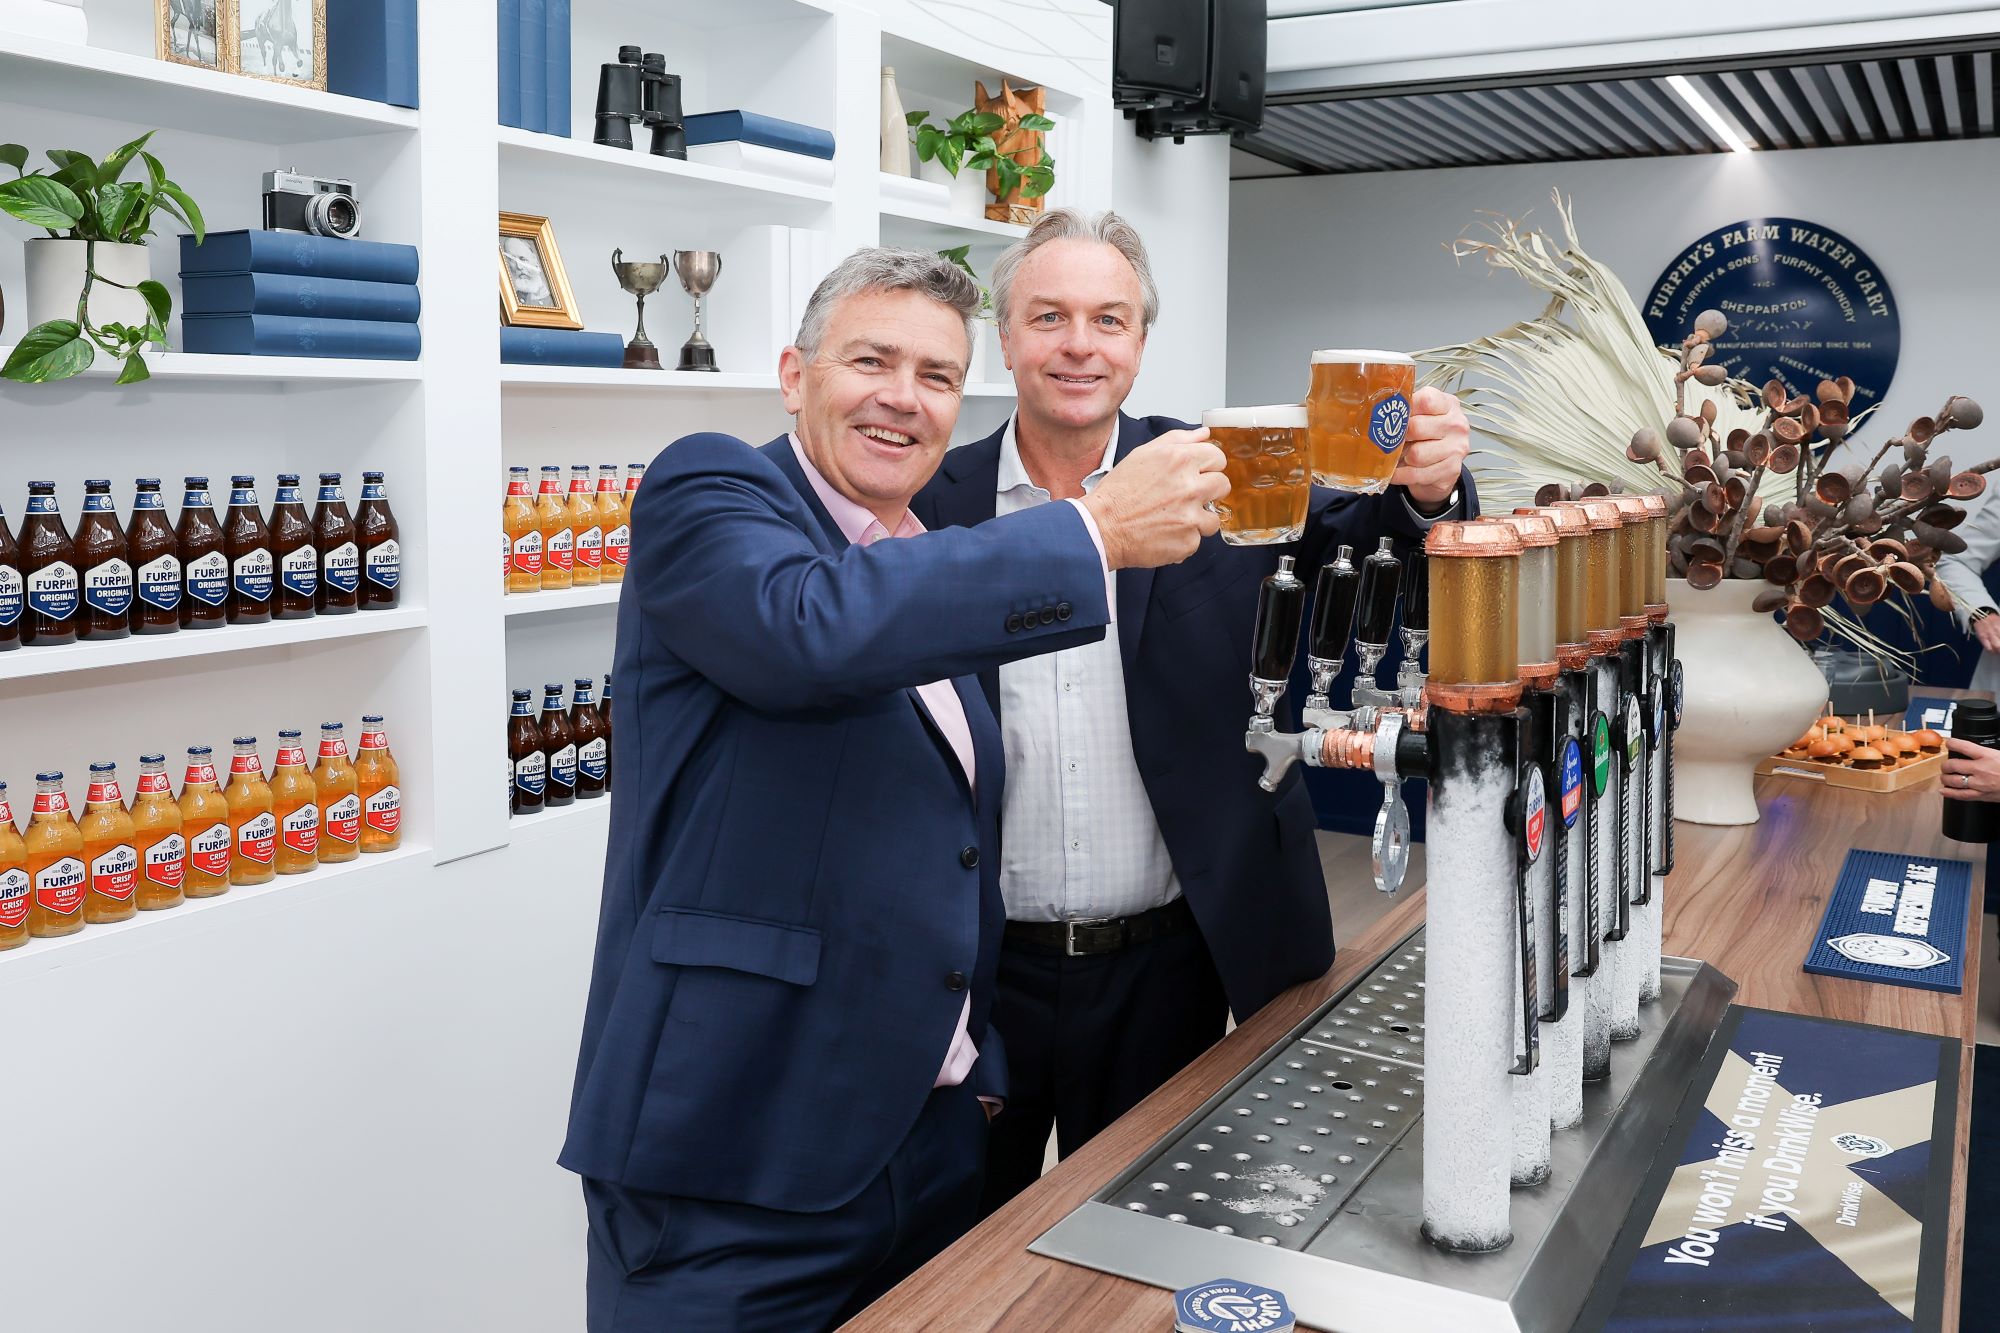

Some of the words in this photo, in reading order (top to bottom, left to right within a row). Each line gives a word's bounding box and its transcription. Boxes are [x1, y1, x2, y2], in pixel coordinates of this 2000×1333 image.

[1727, 254, 1760, 270] SONS
[1649, 242, 1715, 318] FURPHY'S
[1721, 225, 1780, 249] FARM
[1790, 227, 1856, 269] WATER
[1854, 269, 1889, 317] CART
[1773, 253, 1823, 277] FURPHY
[1821, 275, 1856, 323] FOUNDRY
[1720, 299, 1807, 314] SHEPPARTON
[1377, 399, 1408, 419] FURPHY
[36, 579, 75, 590] FURPHY
[93, 575, 130, 586] FURPHY
[197, 580, 227, 589] ORIGINAL
[0, 582, 20, 594] RPHY
[97, 588, 130, 598] ORIGINAL
[150, 584, 180, 593] ORIGINAL
[0, 597, 20, 606] GINAL
[40, 592, 75, 602] ORIGINAL
[381, 810, 398, 820] CRISP
[342, 819, 358, 829] CRISP
[300, 830, 316, 839] CRISP
[256, 839, 273, 849] CRISP
[209, 850, 227, 861] CRISP
[99, 858, 137, 874] FURPHY
[164, 861, 182, 872] CRISP
[43, 871, 83, 888] FURPHY
[111, 874, 132, 884] CRISP
[0, 882, 29, 899] URPHY
[56, 887, 78, 898] CRISP
[2, 899, 24, 910] CRISP
[1735, 1051, 1784, 1112] moment
[1731, 1112, 1761, 1127] a
[1762, 1092, 1823, 1175] DrinkWise.
[1711, 1128, 1756, 1171] miss
[1691, 1167, 1741, 1229] won't
[1759, 1174, 1801, 1214] you
[1742, 1212, 1788, 1232] if
[1663, 1229, 1721, 1267] You
[1208, 1287, 1237, 1295] BORN
[1230, 1293, 1282, 1332] FURPHY
